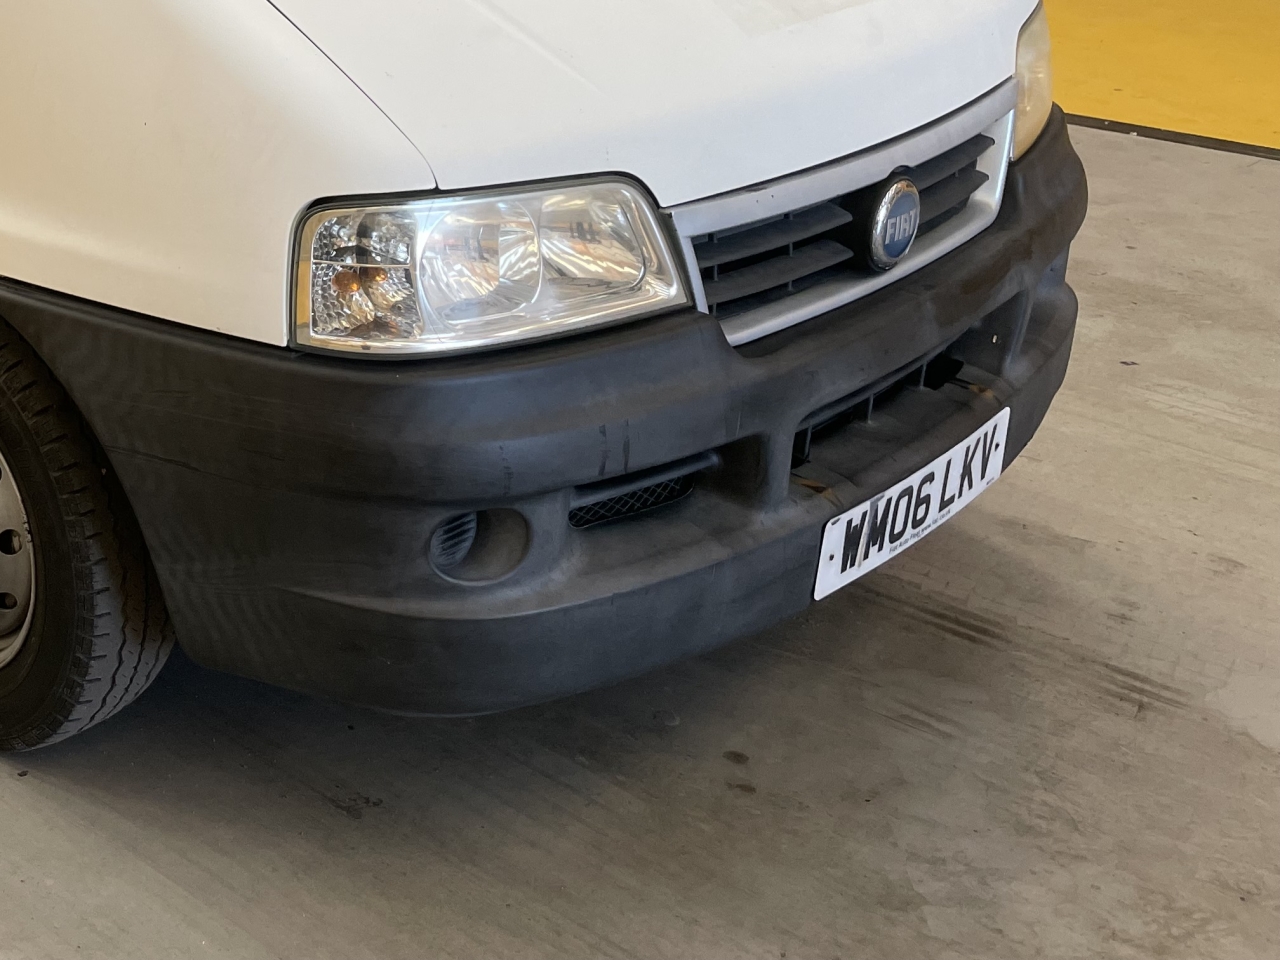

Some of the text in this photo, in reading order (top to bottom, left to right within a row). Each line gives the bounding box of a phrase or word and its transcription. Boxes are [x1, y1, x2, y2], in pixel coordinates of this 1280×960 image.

[884, 208, 917, 246] FIAT
[840, 423, 998, 575] WM06 LKV
